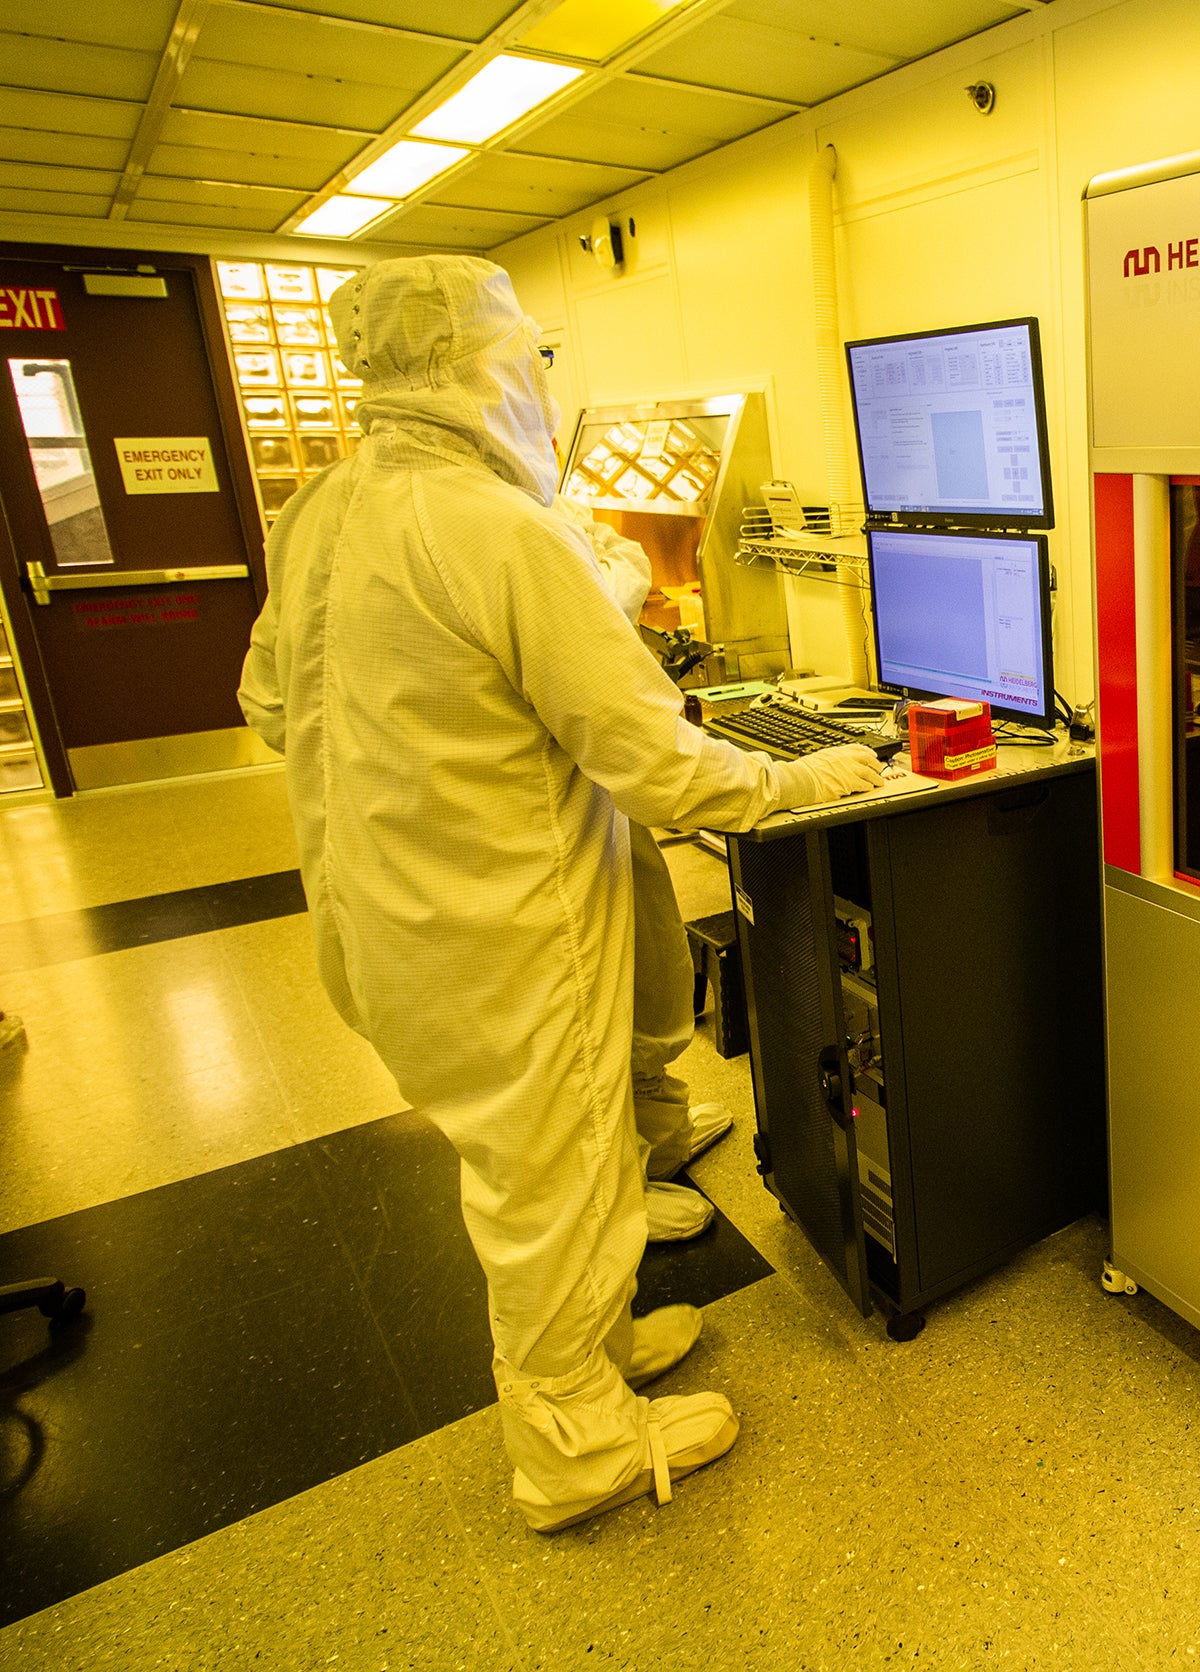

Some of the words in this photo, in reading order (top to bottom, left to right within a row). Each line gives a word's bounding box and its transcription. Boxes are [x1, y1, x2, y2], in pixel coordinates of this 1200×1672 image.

[0, 289, 57, 329] EXIT
[123, 450, 205, 463] EMERGENCY
[134, 469, 162, 481] EXIT
[167, 468, 202, 480] ONLY
[981, 690, 1038, 706] INSTRUMENTS
